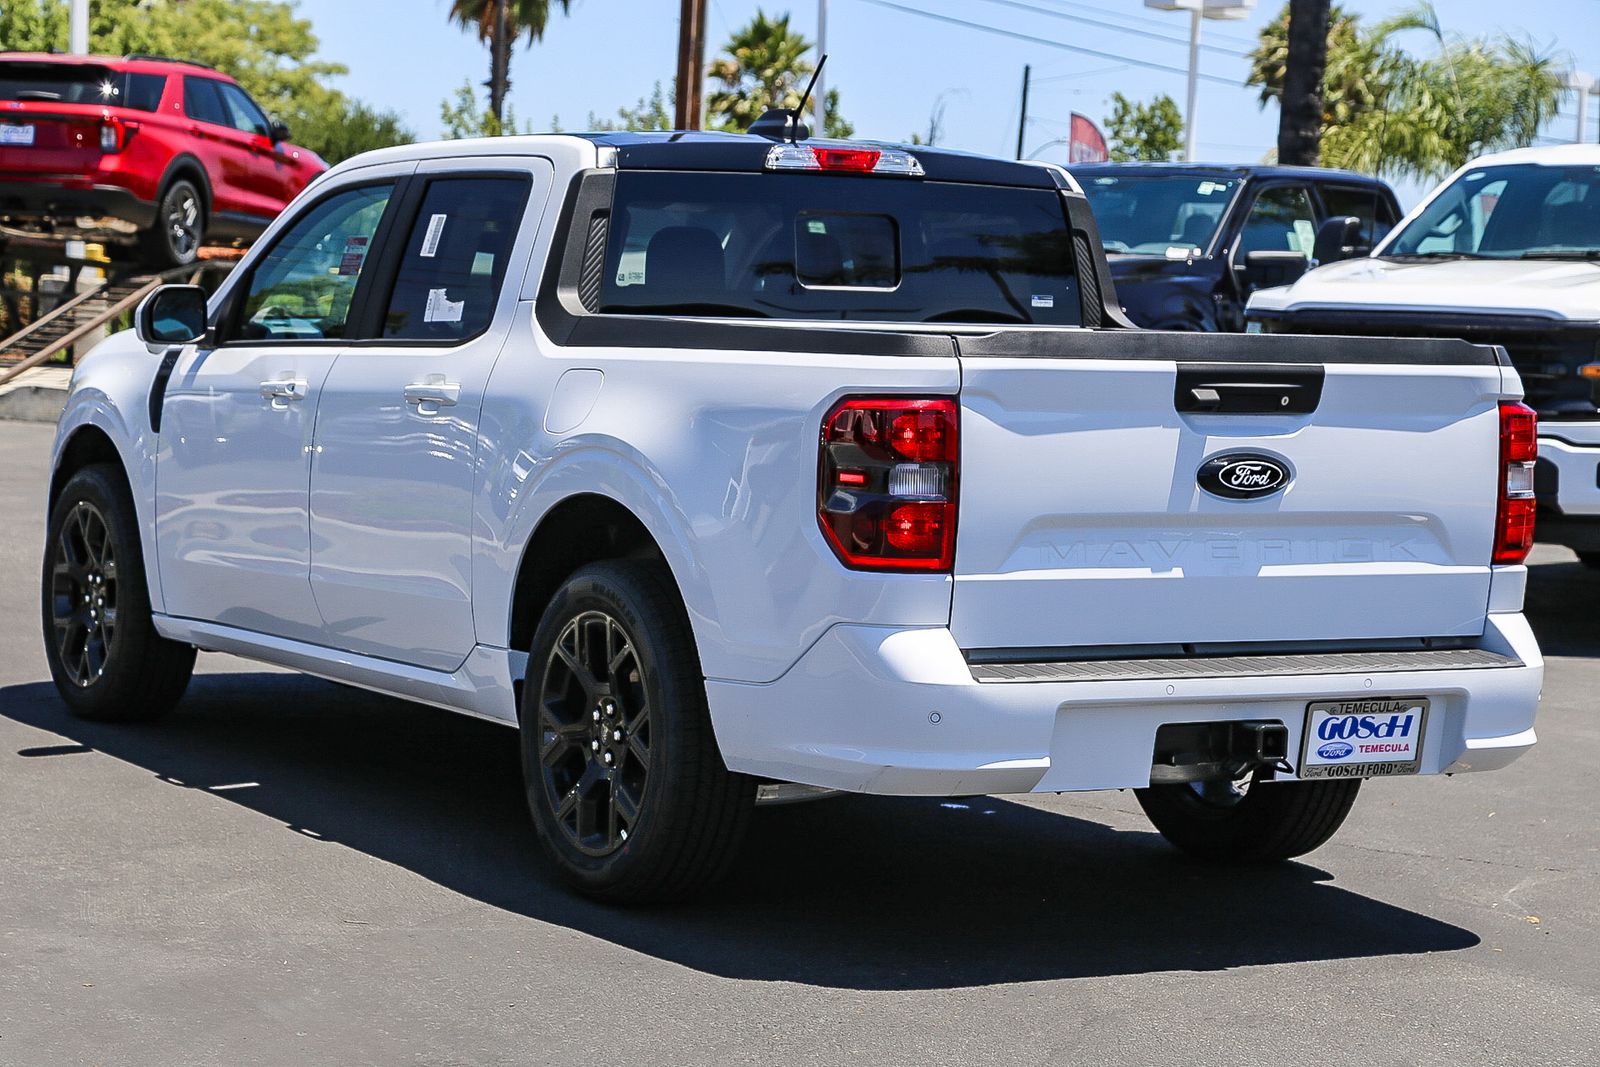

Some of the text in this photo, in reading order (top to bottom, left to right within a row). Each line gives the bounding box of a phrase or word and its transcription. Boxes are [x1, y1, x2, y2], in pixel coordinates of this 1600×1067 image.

[1231, 465, 1271, 485] Ford
[1039, 537, 1419, 564] MAVERICK
[1338, 702, 1400, 714] TEMECULA
[1323, 745, 1348, 757] Ford
[1359, 743, 1410, 753] TEMECULA
[1304, 767, 1323, 777] Ford
[1366, 763, 1393, 775] FORD
